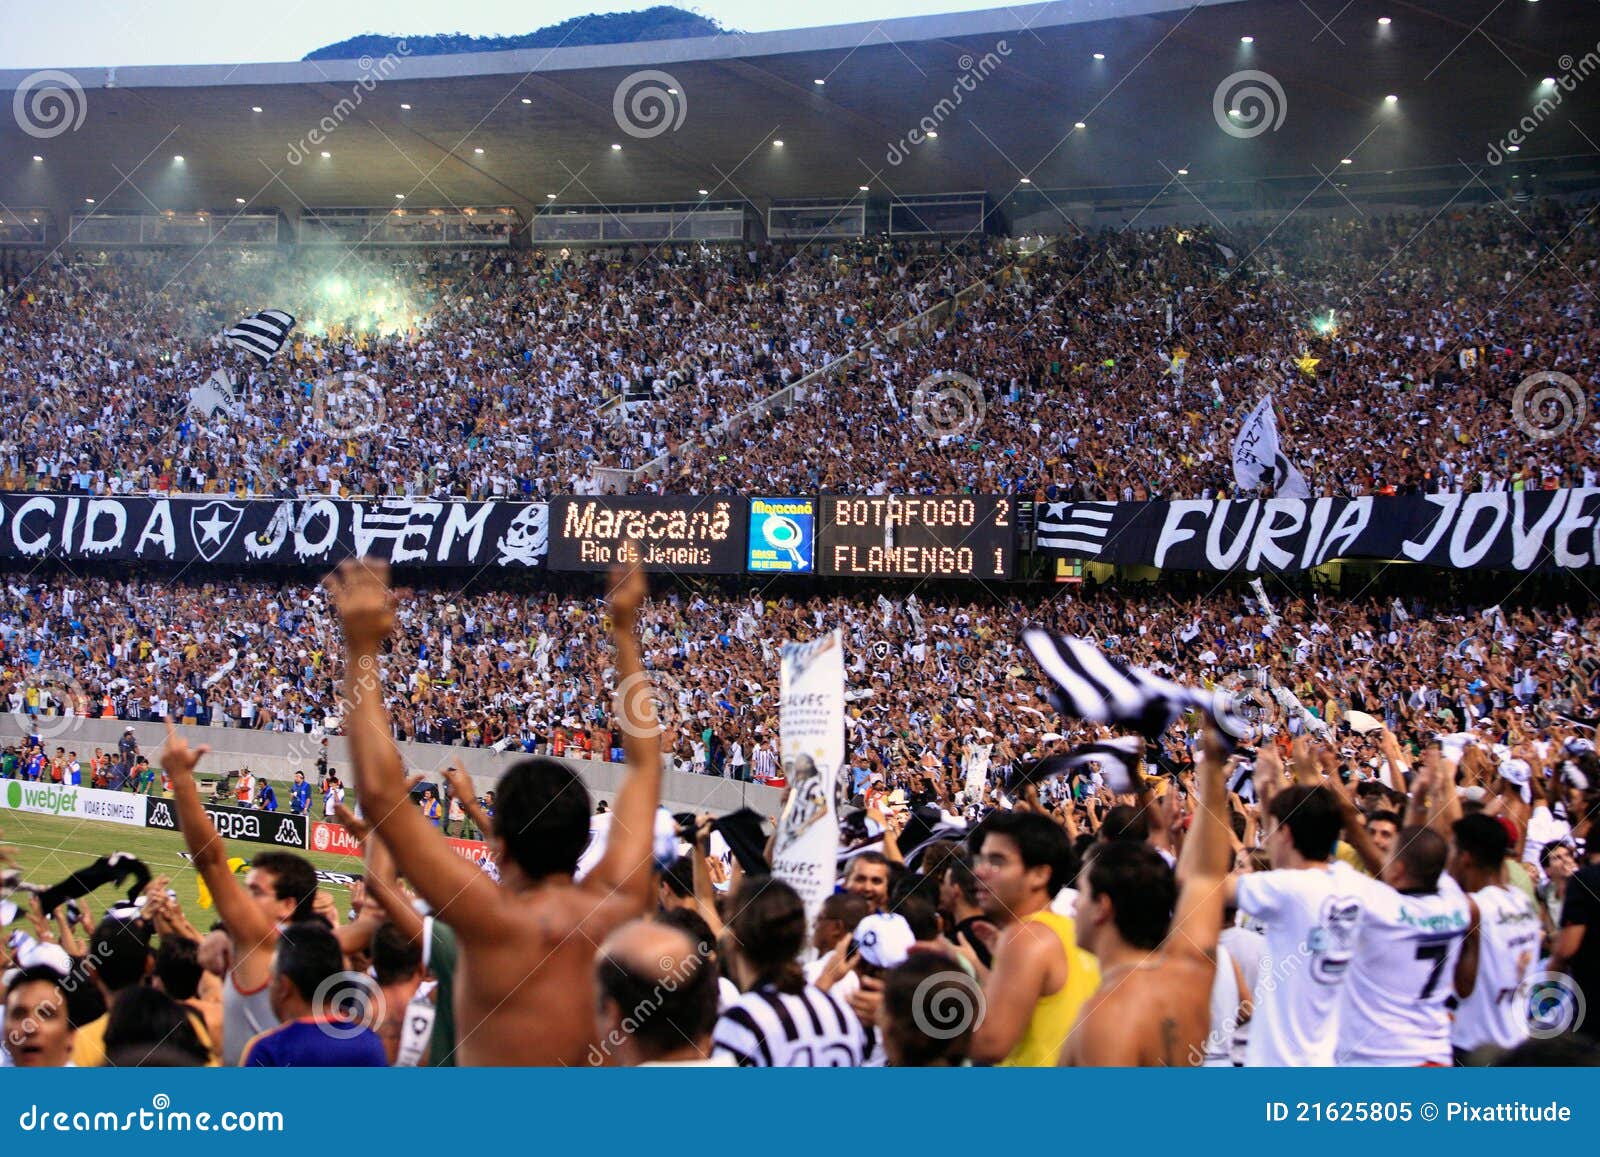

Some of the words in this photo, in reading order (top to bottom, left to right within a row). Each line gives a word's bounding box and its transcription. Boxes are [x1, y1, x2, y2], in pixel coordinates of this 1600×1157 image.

[0, 496, 176, 560] CIDA
[563, 501, 731, 540] Maracanã
[836, 500, 975, 526] BOTAFOGO
[995, 500, 1009, 526] 2
[1402, 488, 1600, 571] JOVE
[581, 541, 611, 562] Rio
[617, 541, 638, 562] de
[643, 542, 711, 564] Janeiro
[834, 545, 973, 573] FLAMENGO
[994, 548, 1005, 574] 1
[25, 786, 78, 814] webjet
[107, 803, 136, 819] SIMPLES
[204, 810, 260, 839] appa
[1416, 944, 1449, 1000] 7
